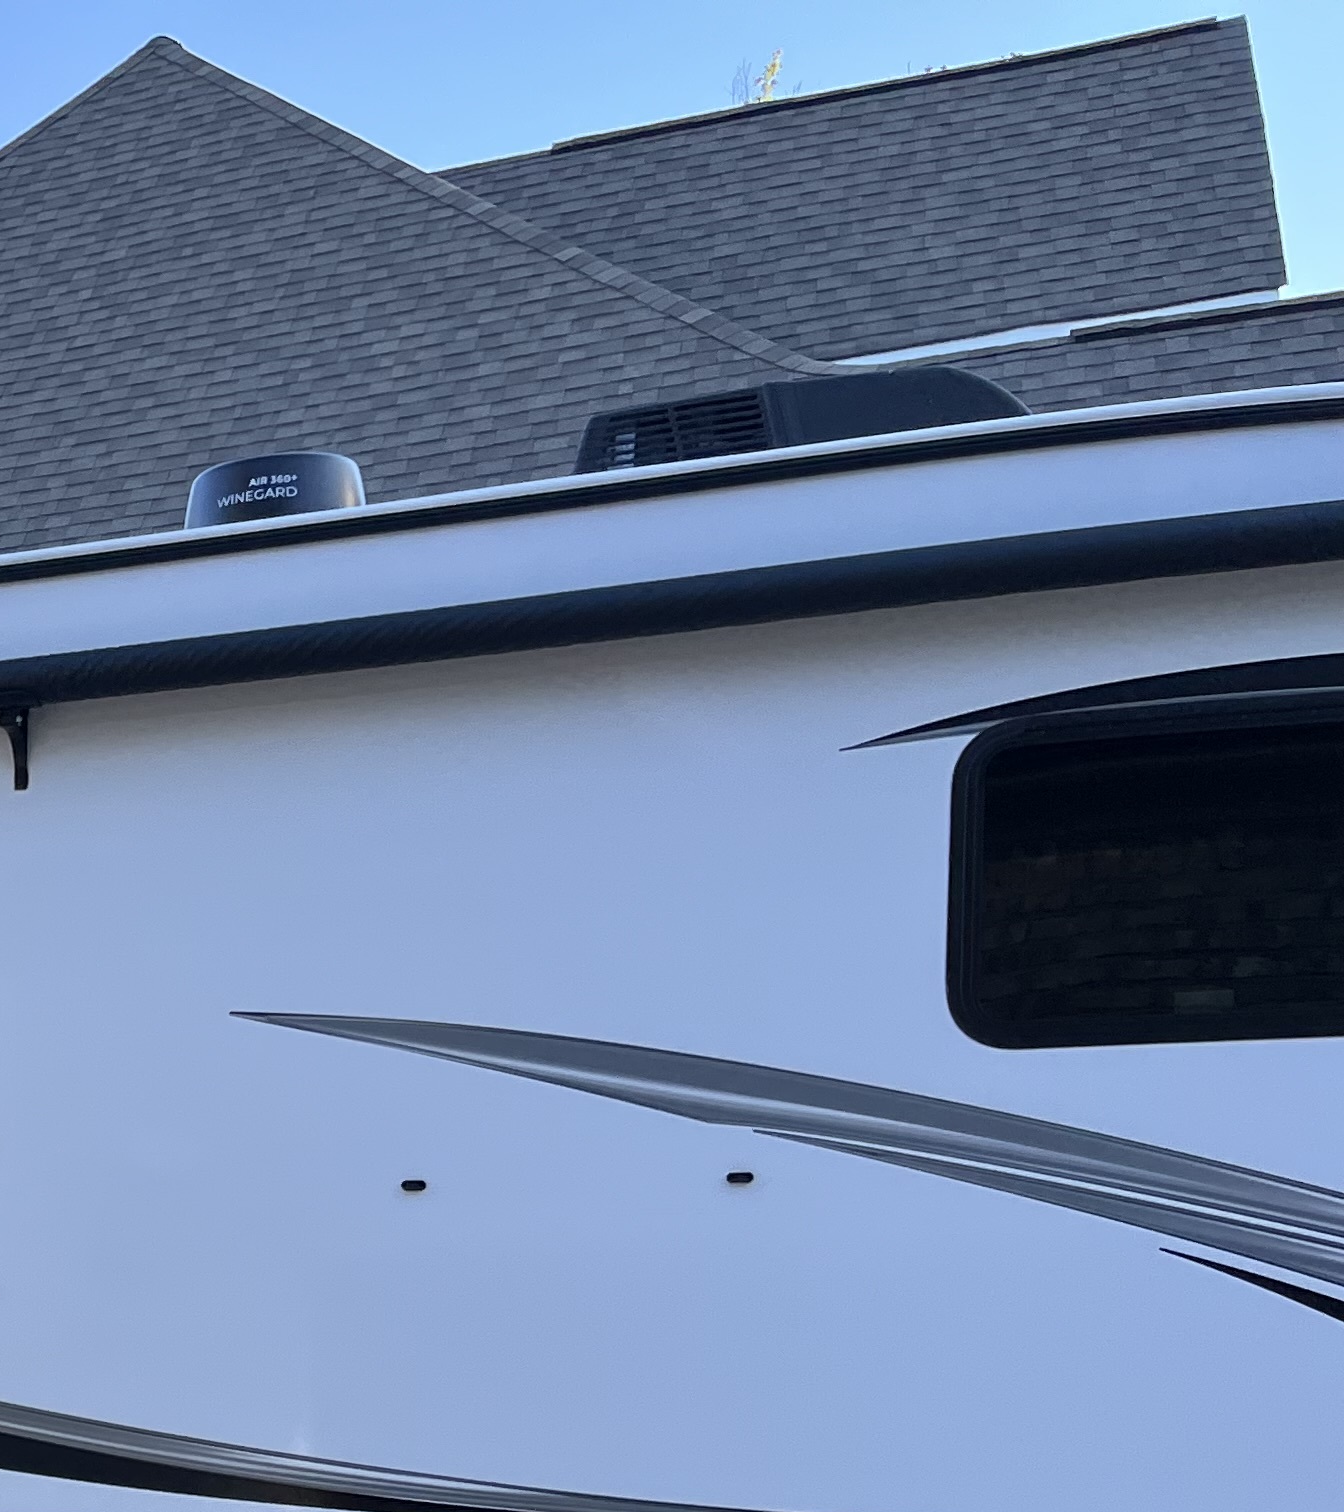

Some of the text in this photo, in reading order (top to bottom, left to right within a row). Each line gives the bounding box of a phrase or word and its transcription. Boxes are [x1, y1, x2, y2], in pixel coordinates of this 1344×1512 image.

[248, 474, 298, 487] AIR 360+
[217, 486, 298, 508] WINEGARD
